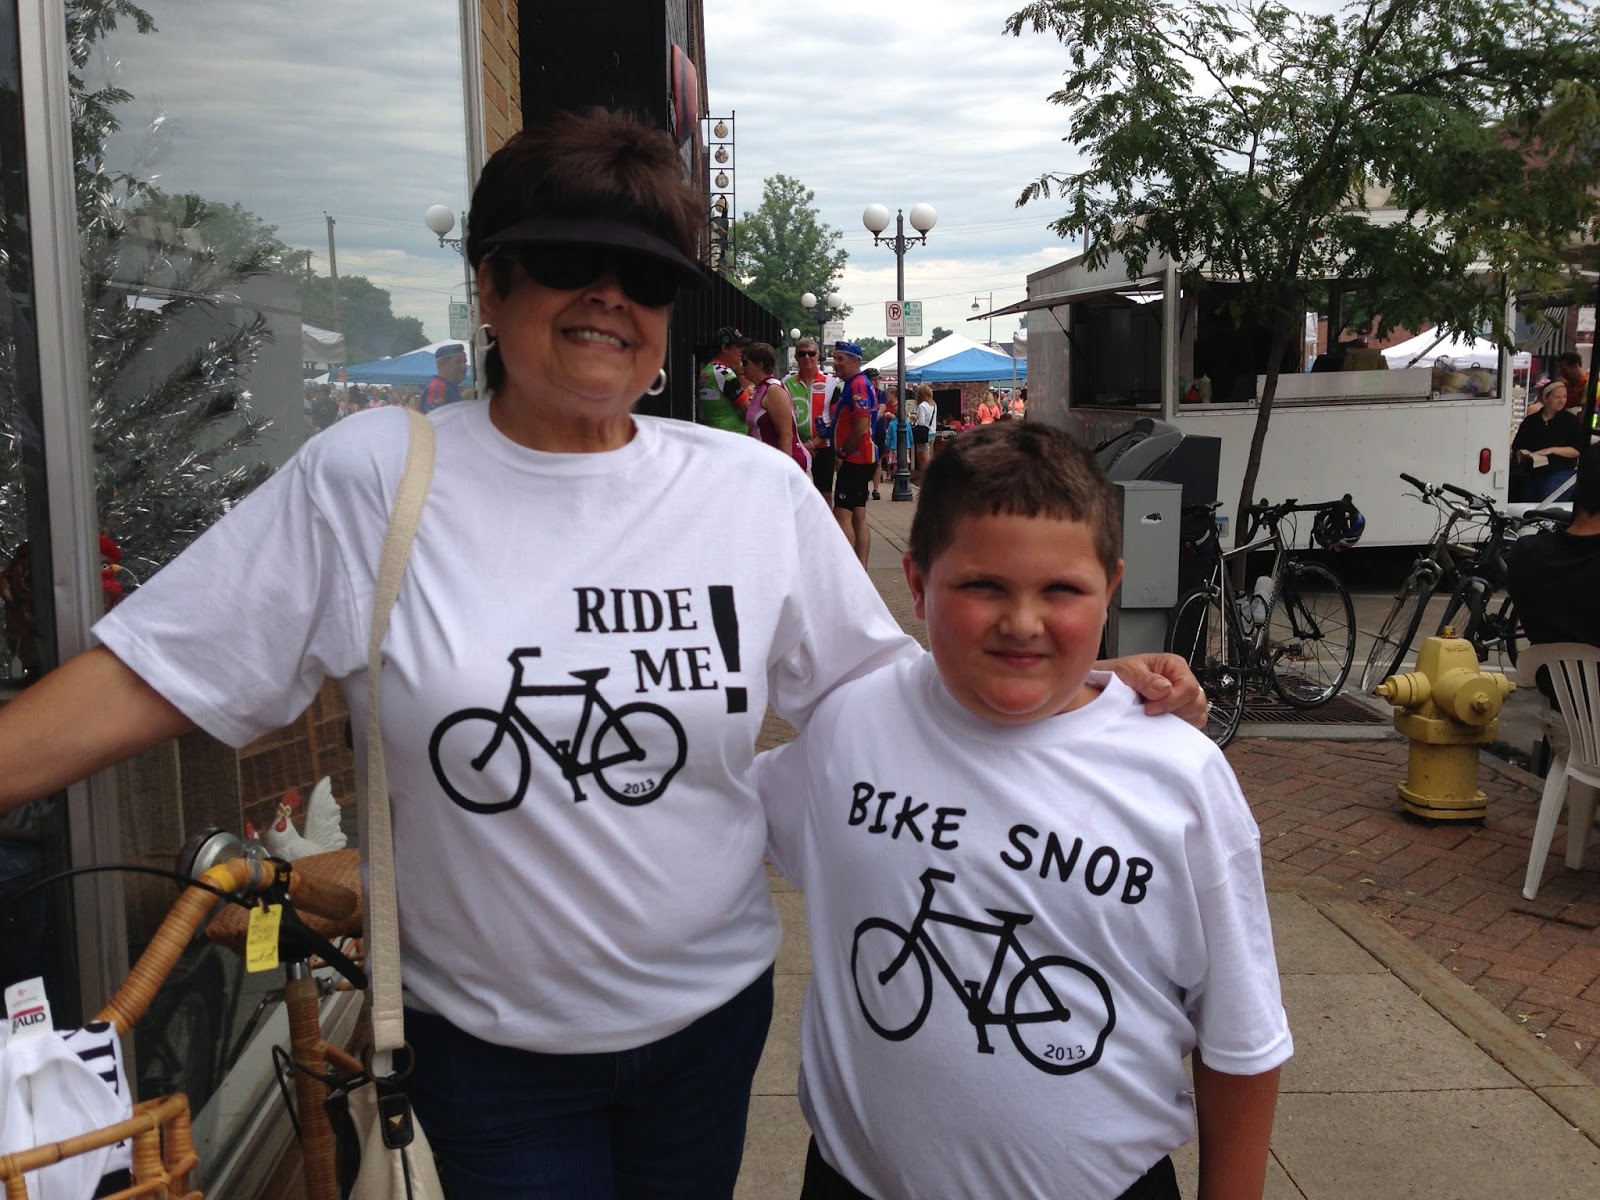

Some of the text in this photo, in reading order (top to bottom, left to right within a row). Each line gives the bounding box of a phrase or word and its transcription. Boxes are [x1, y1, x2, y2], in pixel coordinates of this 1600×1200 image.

[573, 587, 698, 634] RIDE
[623, 778, 656, 796] 2013
[848, 782, 1154, 905] BIKE SNOB
[11, 1011, 47, 1036] anvil
[1043, 1044, 1087, 1061] 2013
